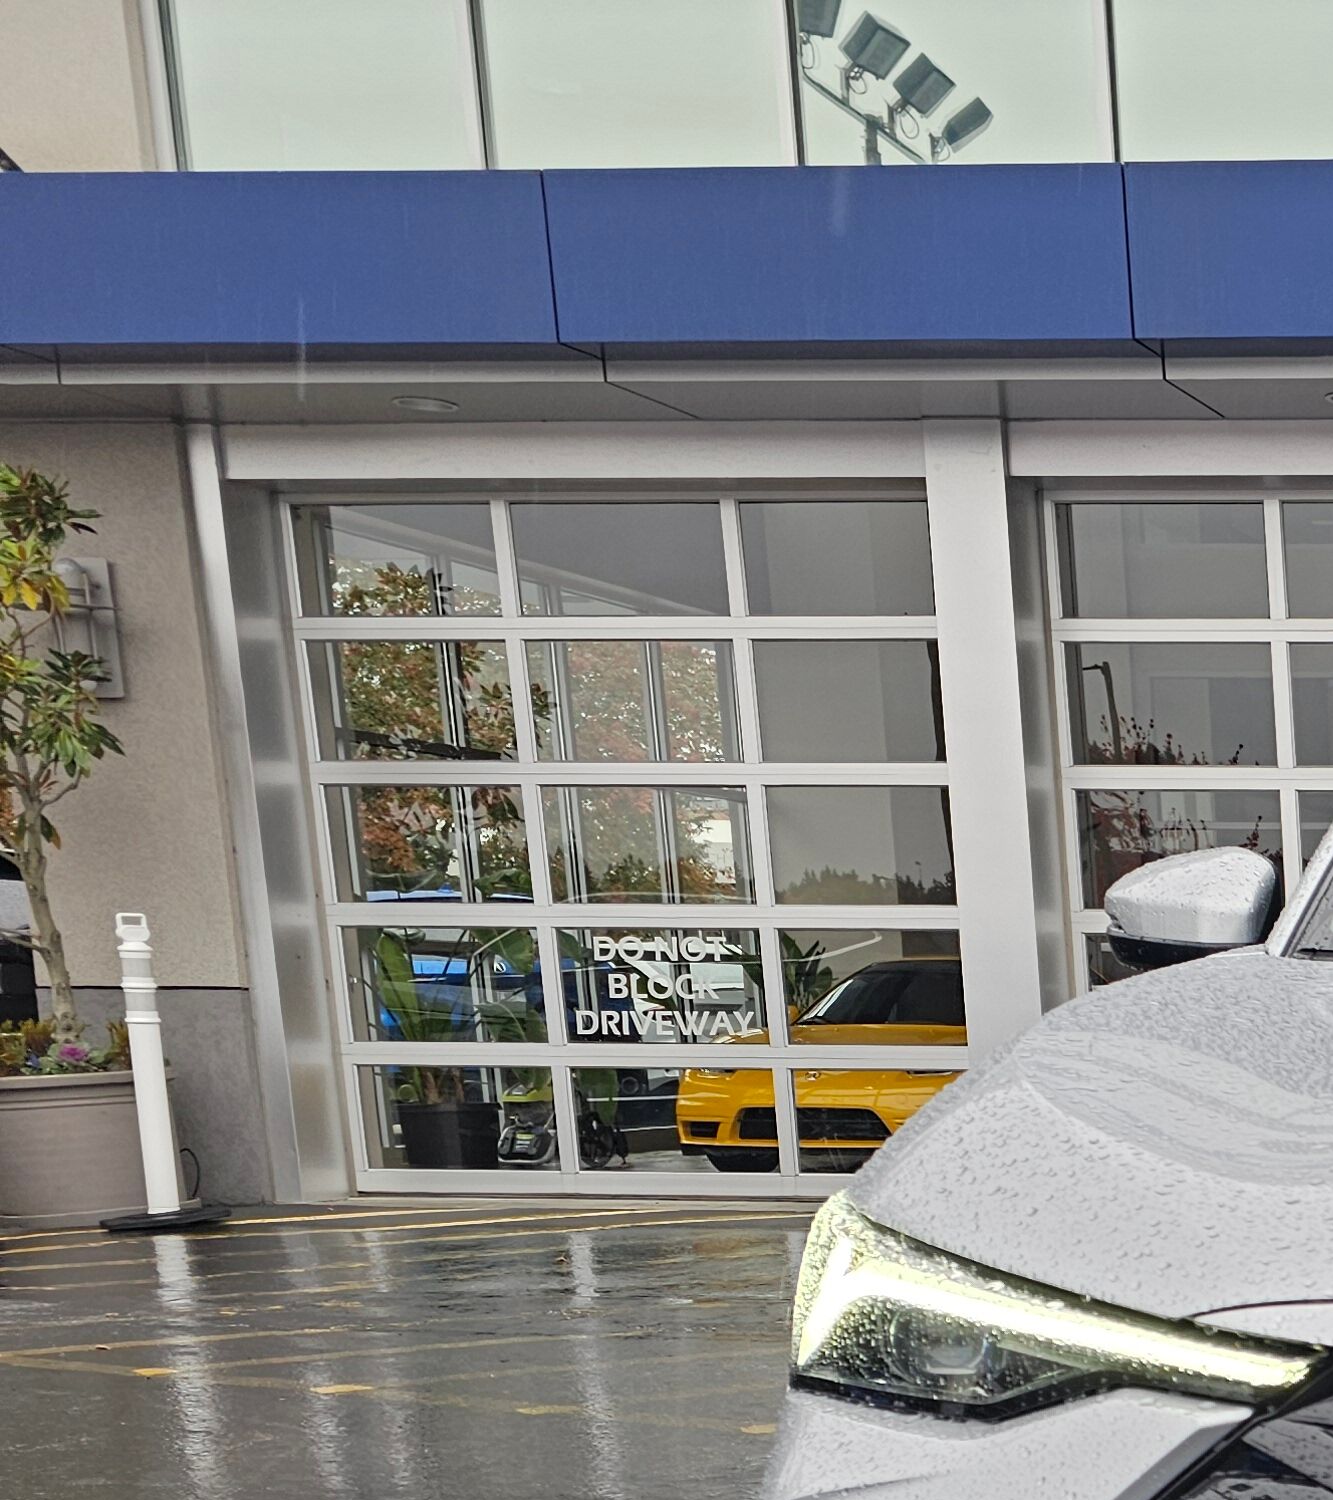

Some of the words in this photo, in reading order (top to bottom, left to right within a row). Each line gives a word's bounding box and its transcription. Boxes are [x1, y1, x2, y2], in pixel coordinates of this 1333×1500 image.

[592, 936, 646, 962] DO
[654, 936, 728, 962] NOT
[607, 972, 719, 1000] BLOCK
[575, 1010, 755, 1036] DRIVEWAY
